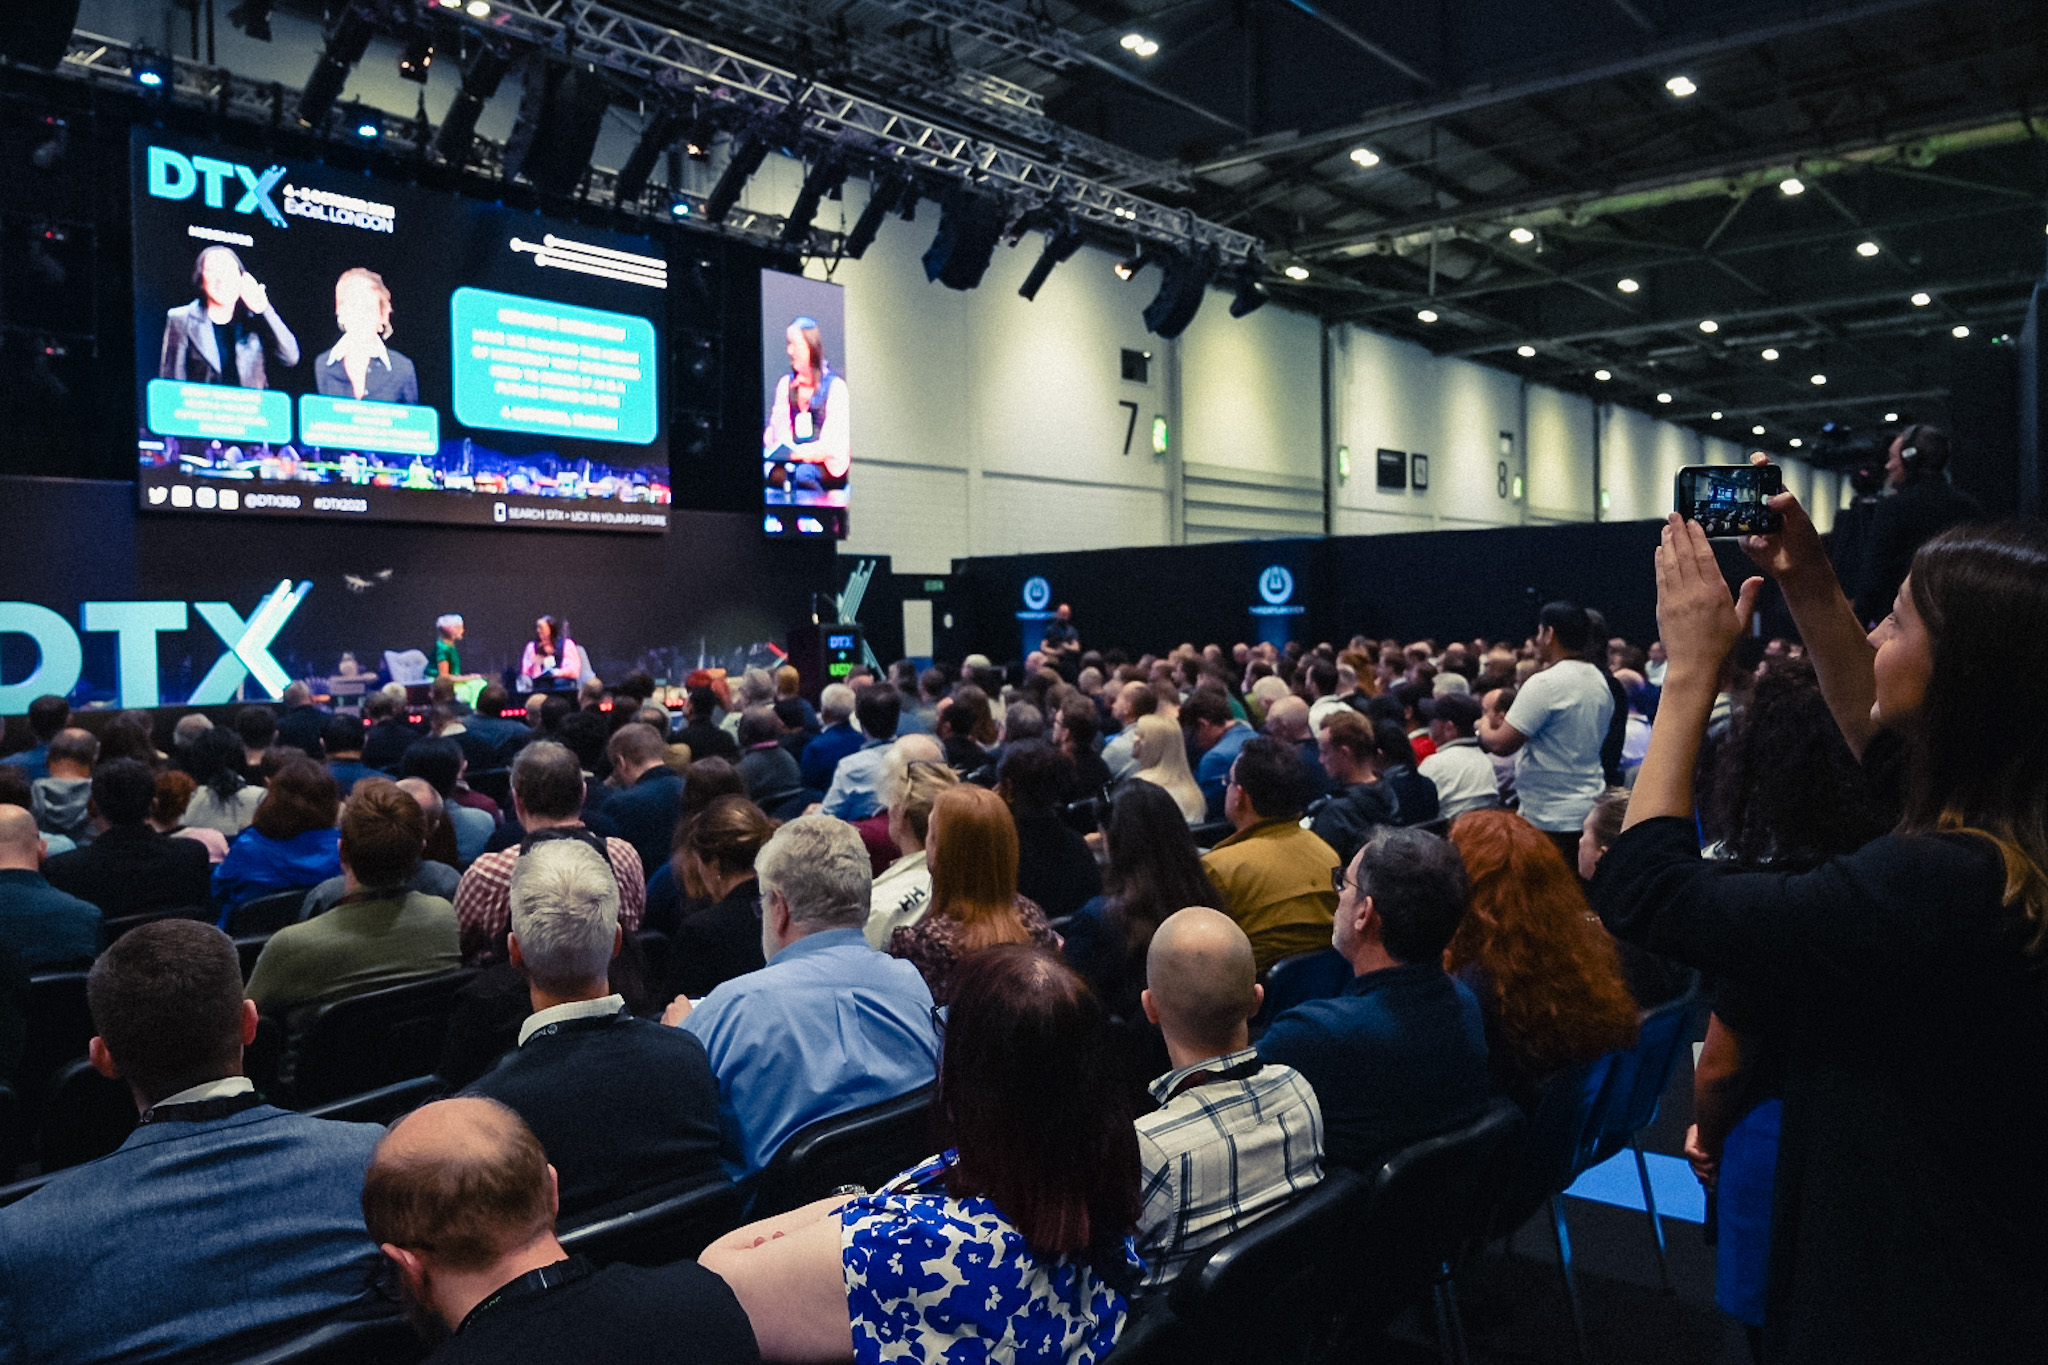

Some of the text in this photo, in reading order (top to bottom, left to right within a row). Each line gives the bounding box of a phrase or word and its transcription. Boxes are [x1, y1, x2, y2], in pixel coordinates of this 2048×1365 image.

[147, 145, 288, 229] DTX
[329, 207, 394, 233] LONDON
[1119, 400, 1138, 456] 7
[1498, 461, 1508, 499] 8
[0, 578, 313, 715] DTX
